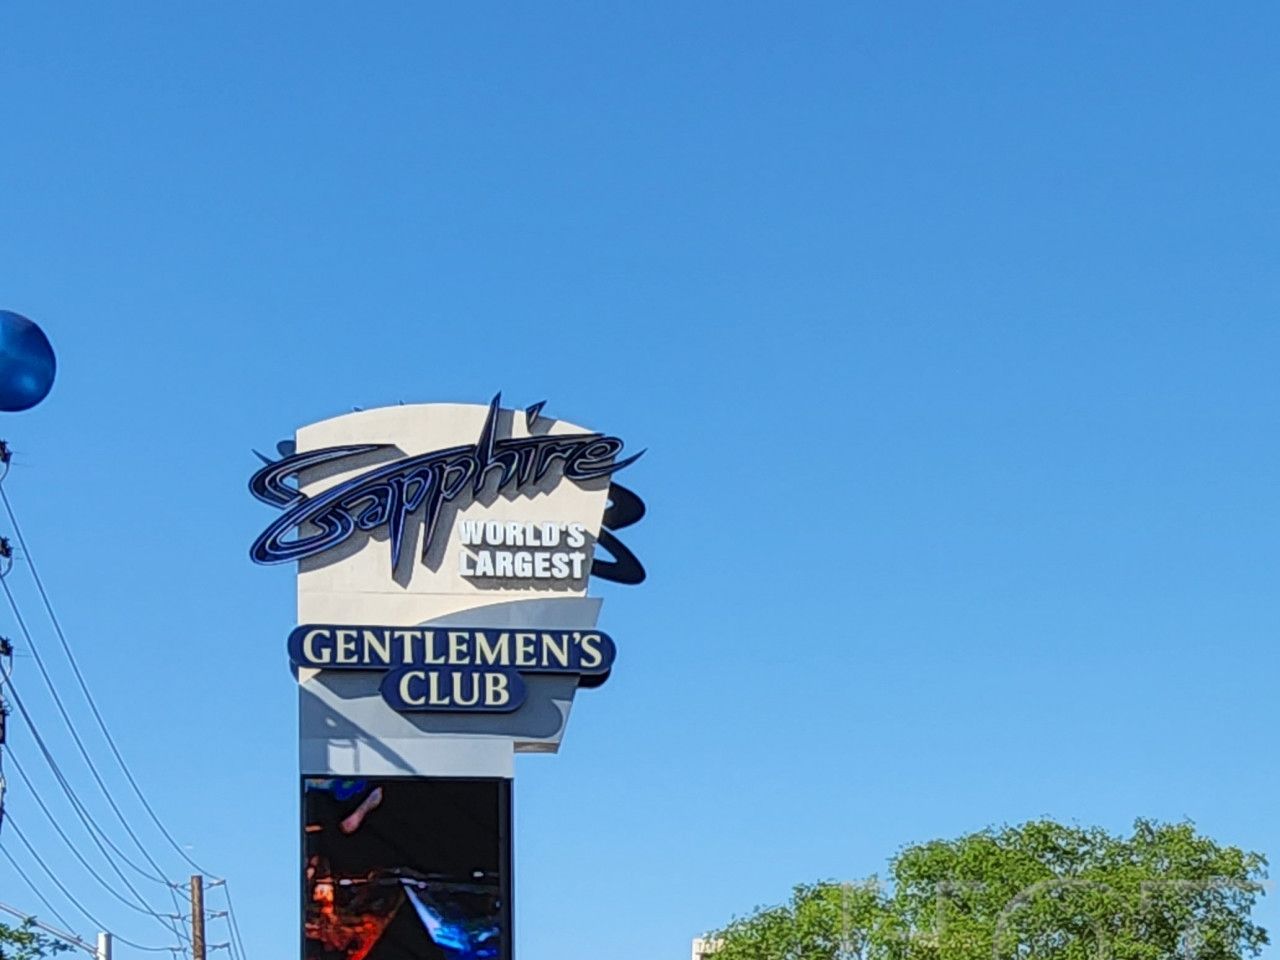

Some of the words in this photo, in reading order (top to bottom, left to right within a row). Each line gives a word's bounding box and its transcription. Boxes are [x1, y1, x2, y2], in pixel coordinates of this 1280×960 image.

[248, 390, 647, 578] Sapphire
[458, 520, 586, 548] WORLD'S
[458, 550, 586, 579] LARGEST
[302, 629, 603, 668] GENTLEMEN'S
[398, 670, 511, 706] CLUB
